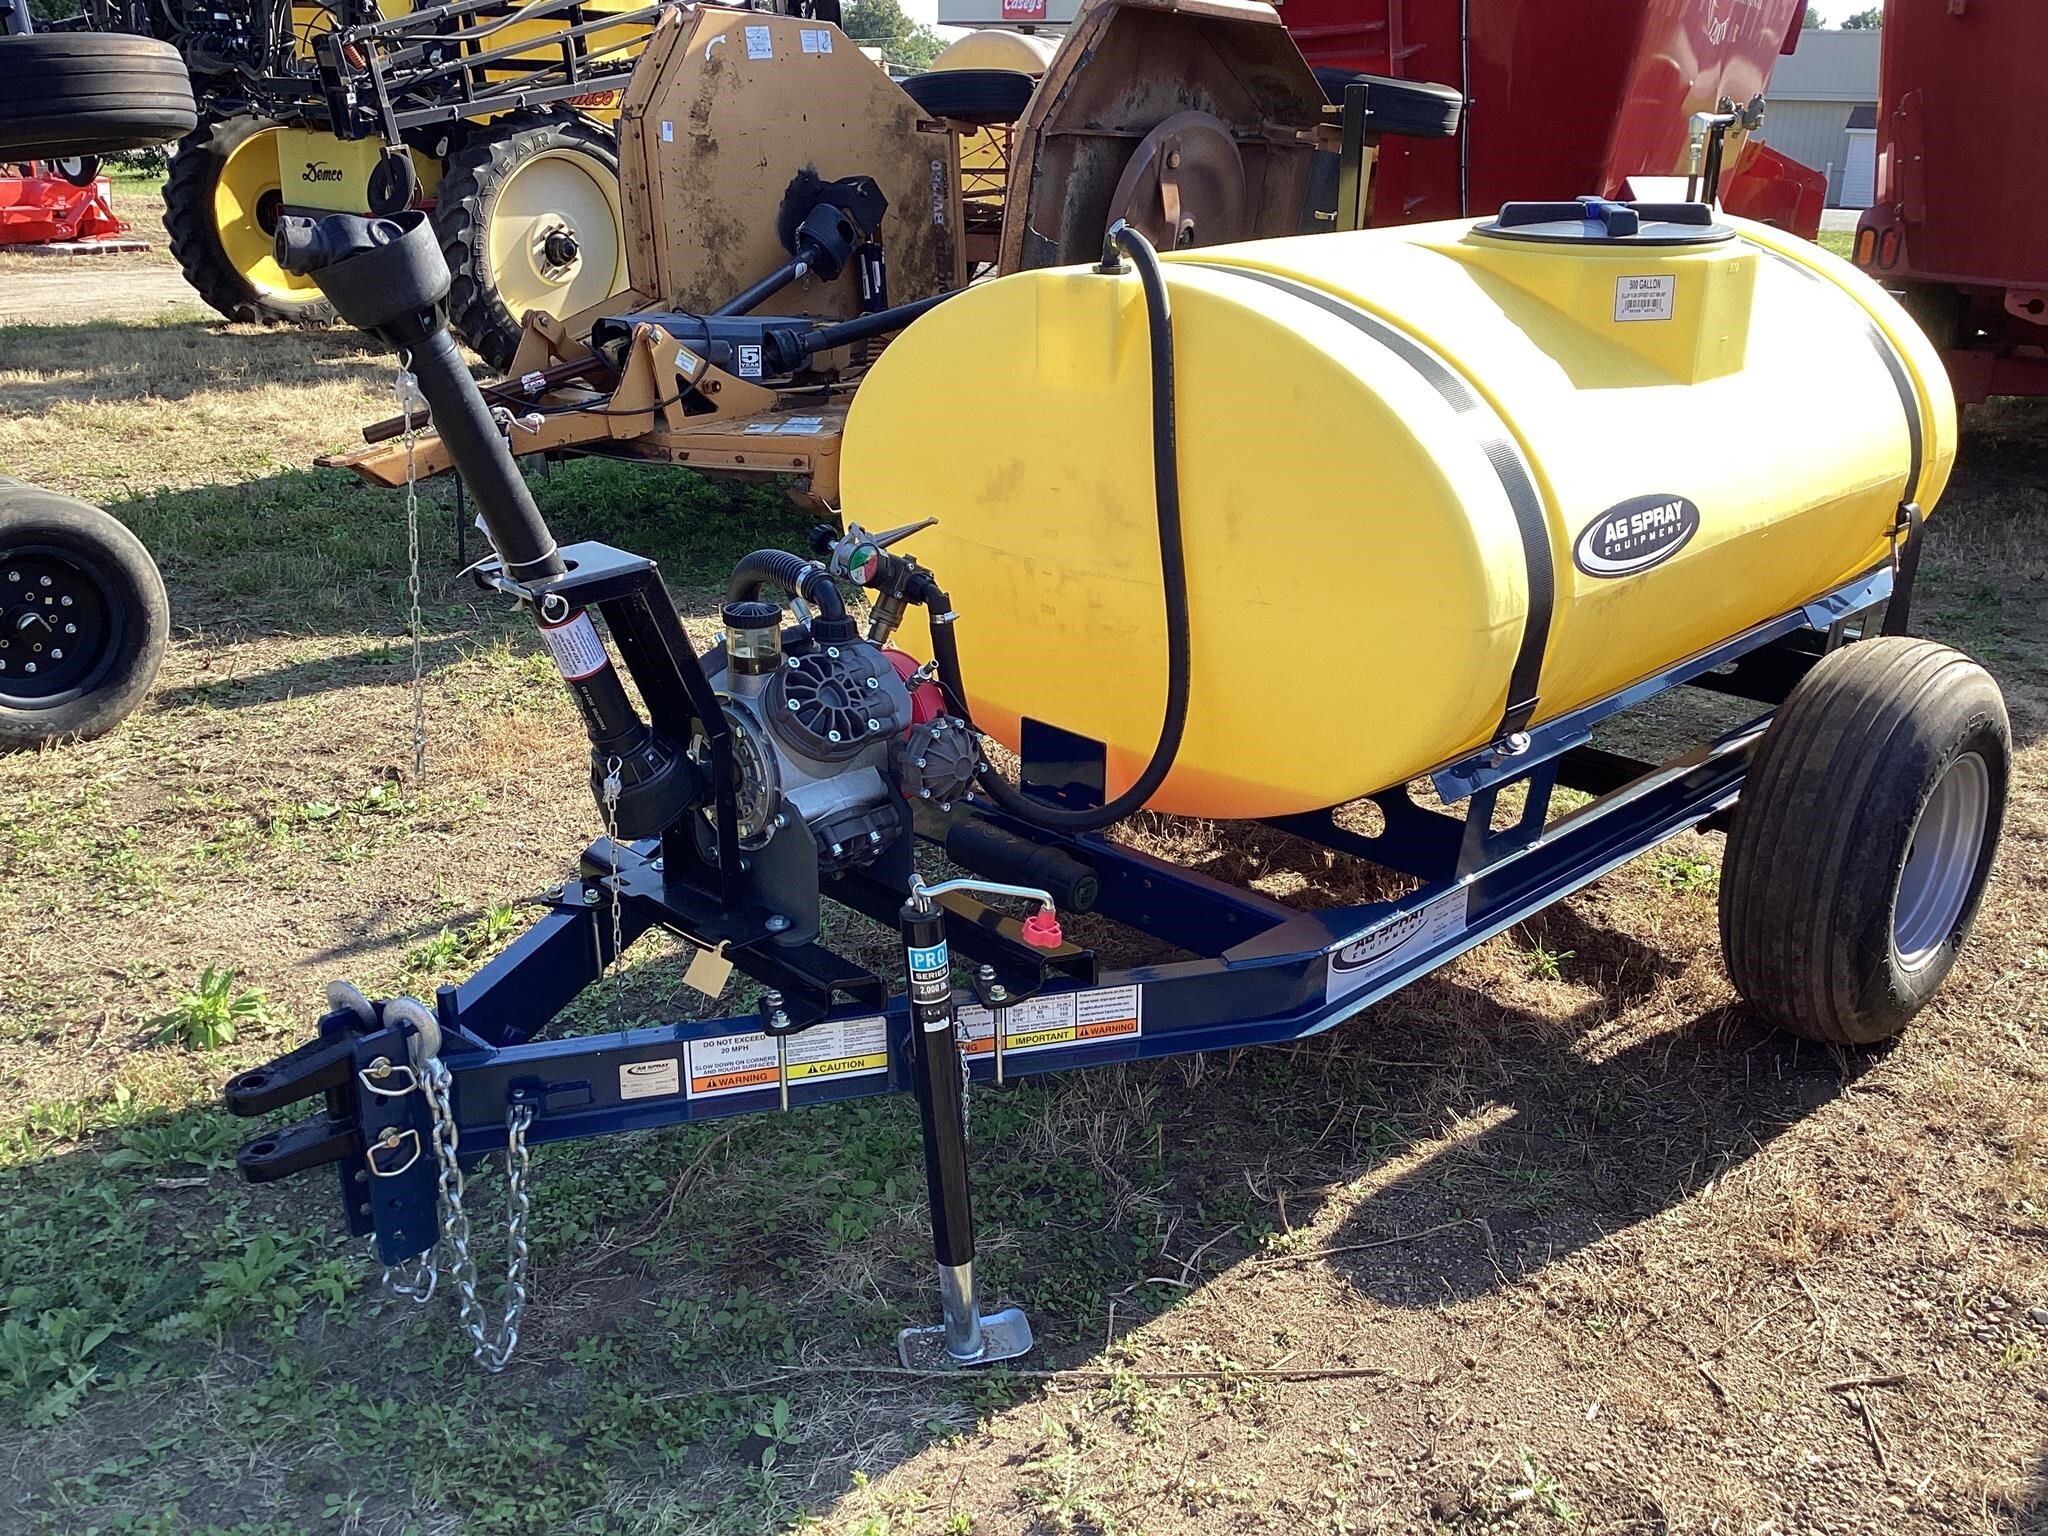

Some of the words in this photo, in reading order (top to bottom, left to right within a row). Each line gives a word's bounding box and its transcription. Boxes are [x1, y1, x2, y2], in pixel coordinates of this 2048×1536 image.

[302, 161, 343, 183] Demco
[1629, 279, 1638, 290] 500
[1639, 278, 1661, 289] GALLON
[741, 347, 759, 363] 5
[1605, 517, 1629, 544] AG
[1631, 500, 1683, 535] SPRAY
[1605, 522, 1682, 556] EQUIPMENT
[1352, 919, 1423, 960] EQUIPMENT
[914, 947, 946, 968] PRO
[915, 966, 947, 980] SERIES
[1090, 1023, 1134, 1036] WARNING
[716, 1039, 733, 1047] NOT
[734, 1034, 766, 1045] EXCEED
[1015, 1031, 1070, 1045] IMPORTANT
[731, 1045, 749, 1053] MPH
[713, 1061, 734, 1069] DOWN
[746, 1055, 777, 1065] CORNERS
[718, 1065, 741, 1074] ROUGH
[742, 1061, 775, 1071] SURFACES
[819, 1059, 865, 1073] CAUTION
[719, 1072, 768, 1087] WARNING
